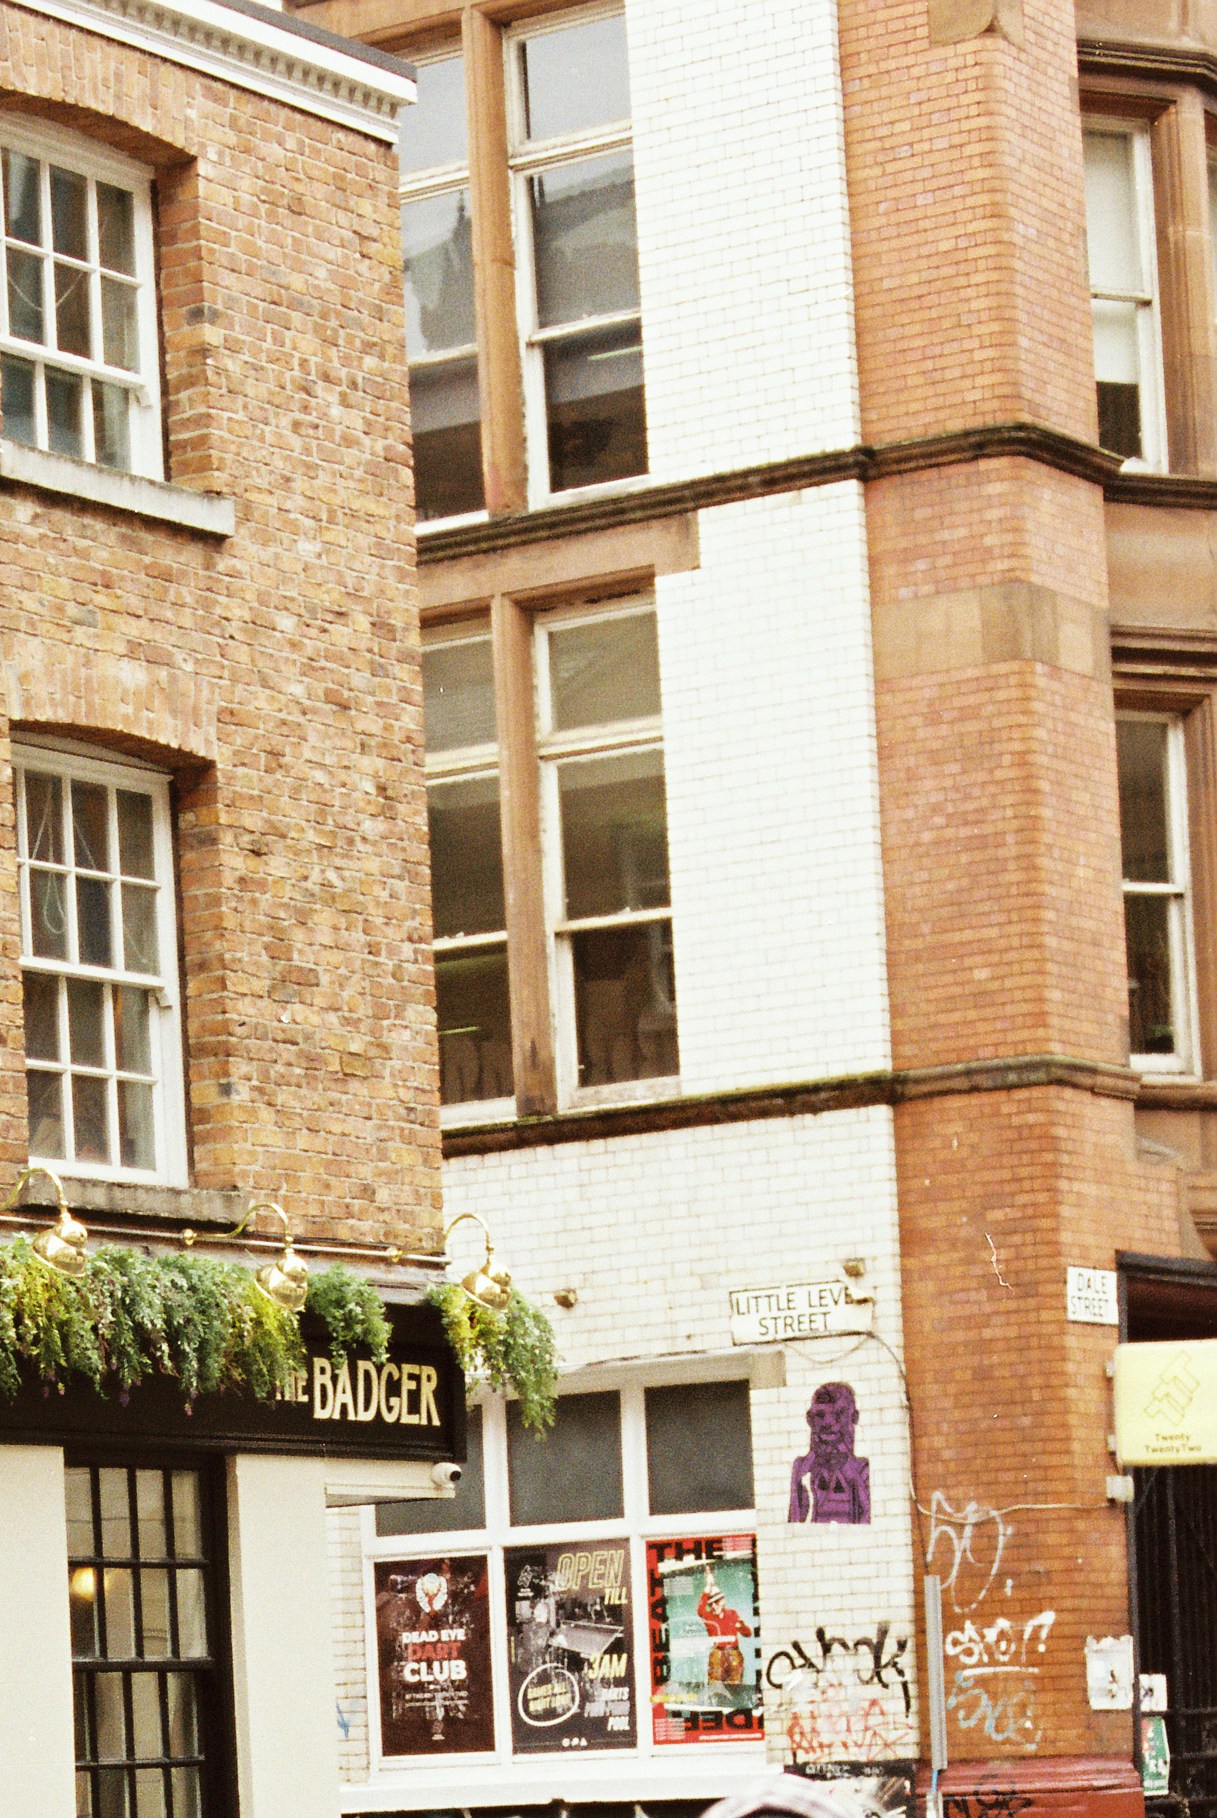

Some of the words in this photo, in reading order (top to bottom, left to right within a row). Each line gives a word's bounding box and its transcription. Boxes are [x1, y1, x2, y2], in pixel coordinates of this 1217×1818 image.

[1077, 1272, 1108, 1295] DALE
[736, 1291, 796, 1316] LITTLE
[1070, 1295, 1110, 1318] STREET
[759, 1312, 832, 1336] STREET
[313, 1357, 441, 1427] BADGER
[648, 1539, 723, 1563] THE
[556, 1549, 625, 1591] OPEN
[603, 1586, 629, 1606] TILL
[401, 1629, 439, 1644] DEAD
[440, 1628, 466, 1641] EYE
[648, 1569, 672, 1687] BEAT
[408, 1643, 461, 1661] DART
[403, 1660, 468, 1683] CLUB
[588, 1652, 627, 1680] 3AM
